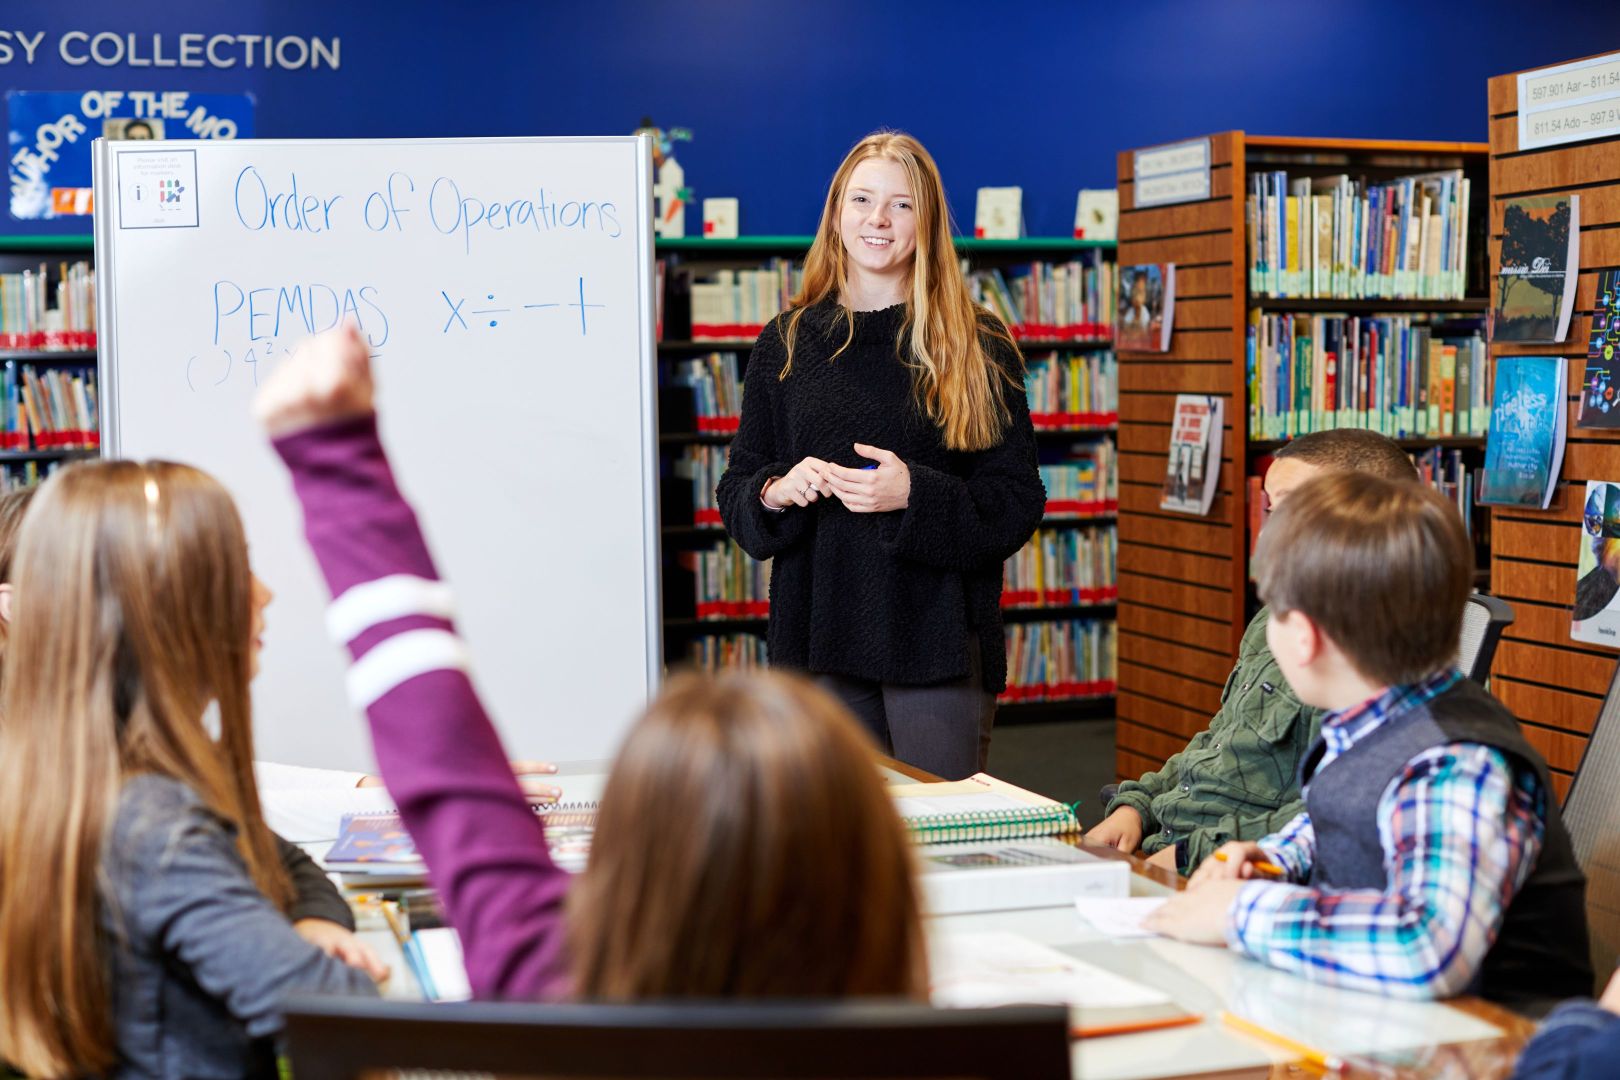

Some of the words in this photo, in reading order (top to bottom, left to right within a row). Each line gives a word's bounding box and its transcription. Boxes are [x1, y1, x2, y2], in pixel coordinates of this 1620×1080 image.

[59, 31, 341, 70] COLLECTION
[80, 90, 124, 119] OF
[128, 91, 190, 119] THE
[1532, 83, 1565, 101] 597.901
[1534, 119, 1562, 135] 811.54
[1563, 116, 1581, 130] Ado
[1590, 109, 1615, 126] 997.9
[235, 165, 344, 233] Order
[364, 171, 415, 232] of
[429, 176, 622, 255] Operations
[213, 280, 389, 348] PEMDAS
